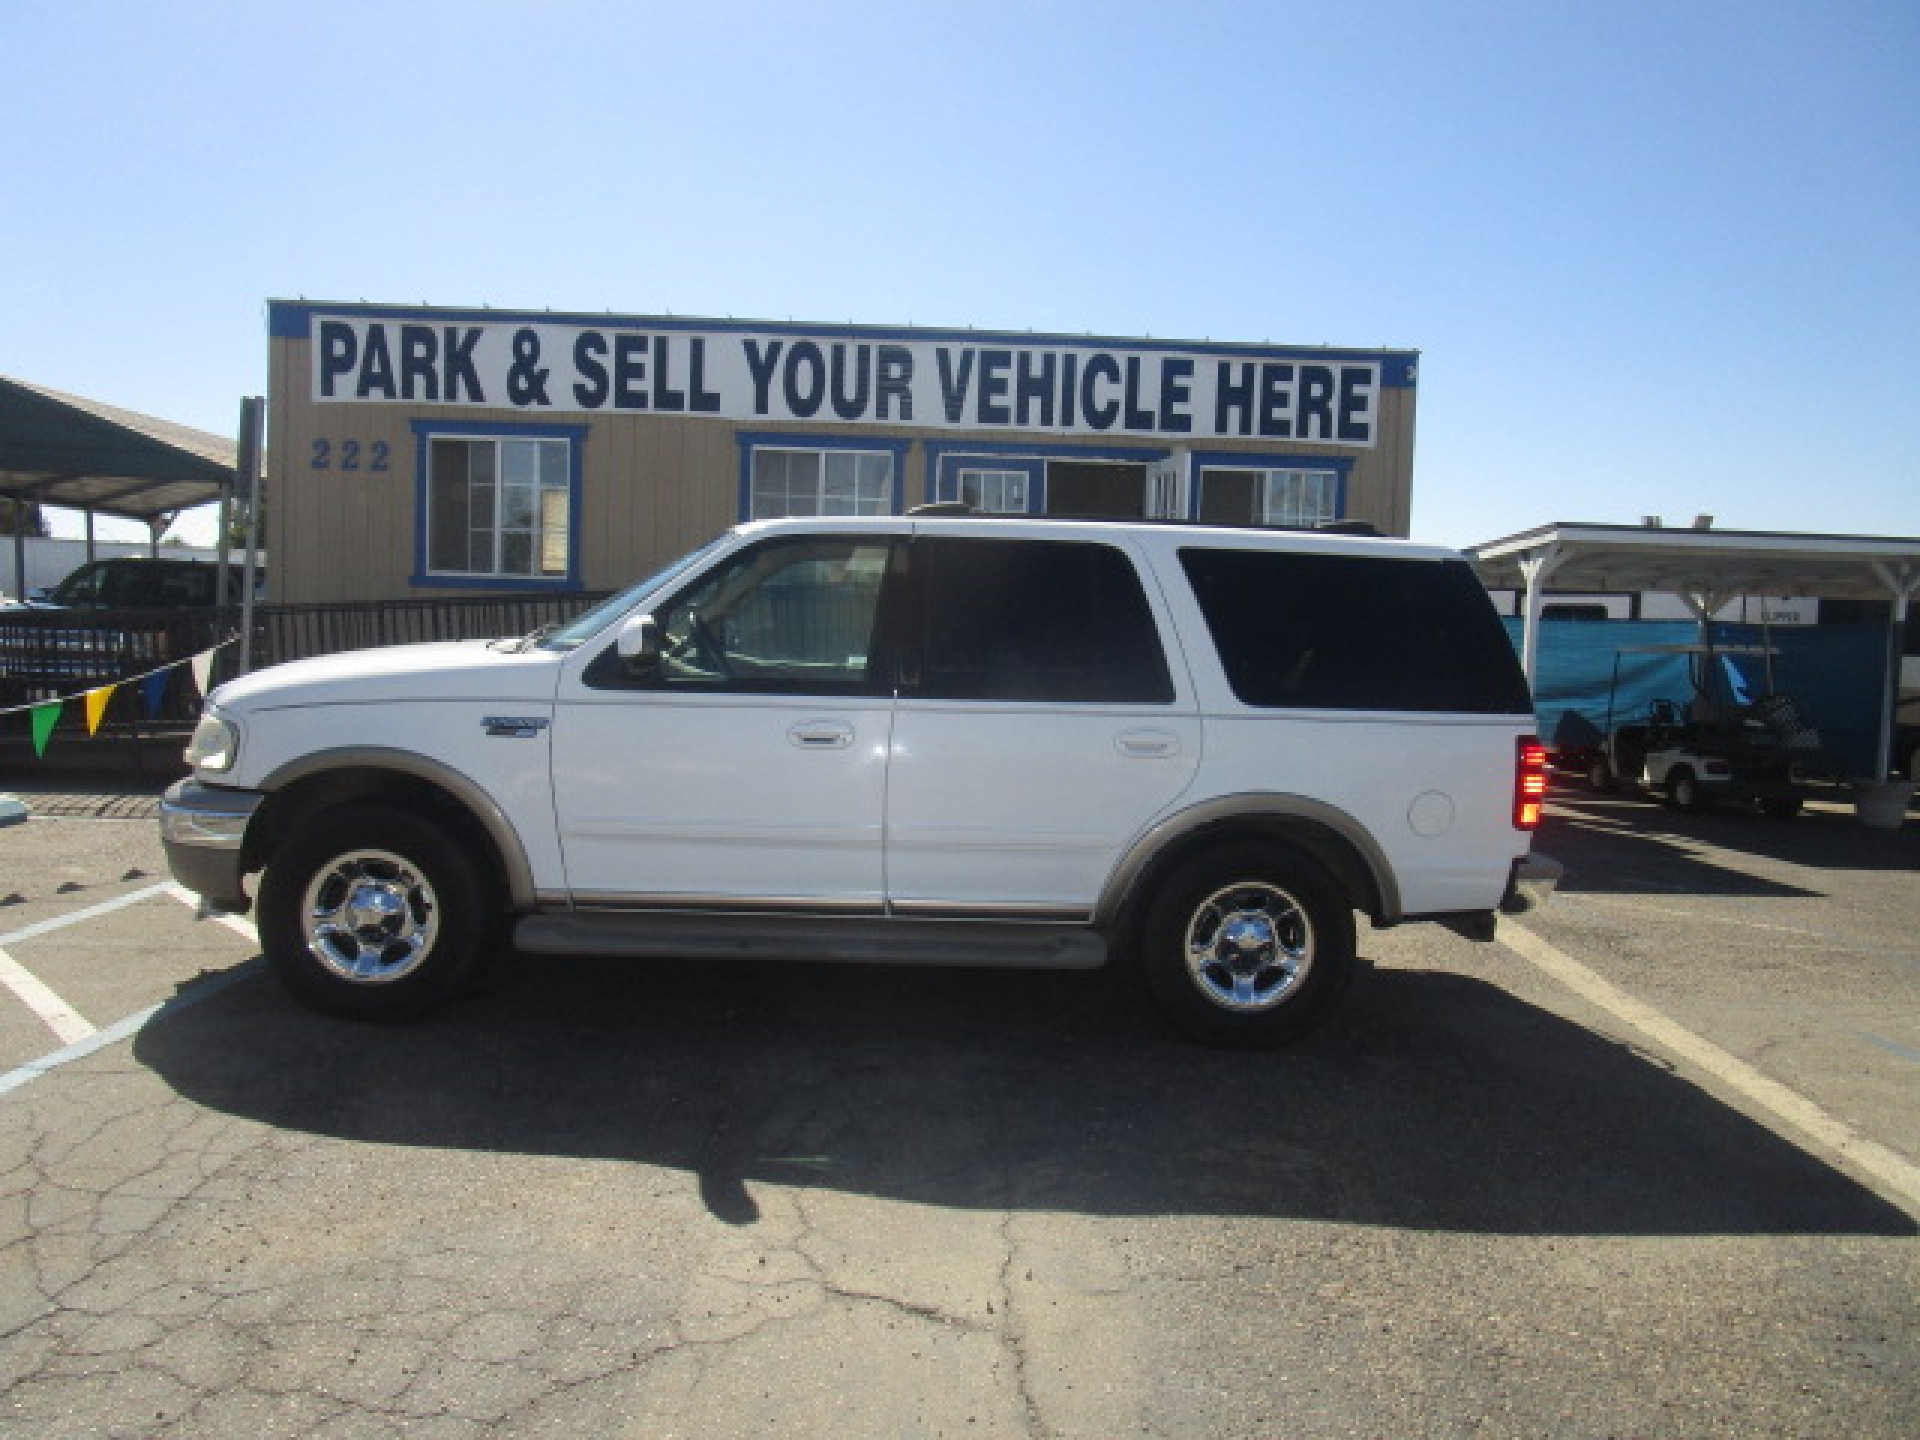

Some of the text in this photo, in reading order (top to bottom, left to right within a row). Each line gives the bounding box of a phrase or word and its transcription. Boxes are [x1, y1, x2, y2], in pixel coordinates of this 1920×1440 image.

[321, 320, 1372, 442] PARK & SELL YOUR VEHICLE HERE
[310, 438, 391, 472] 222
